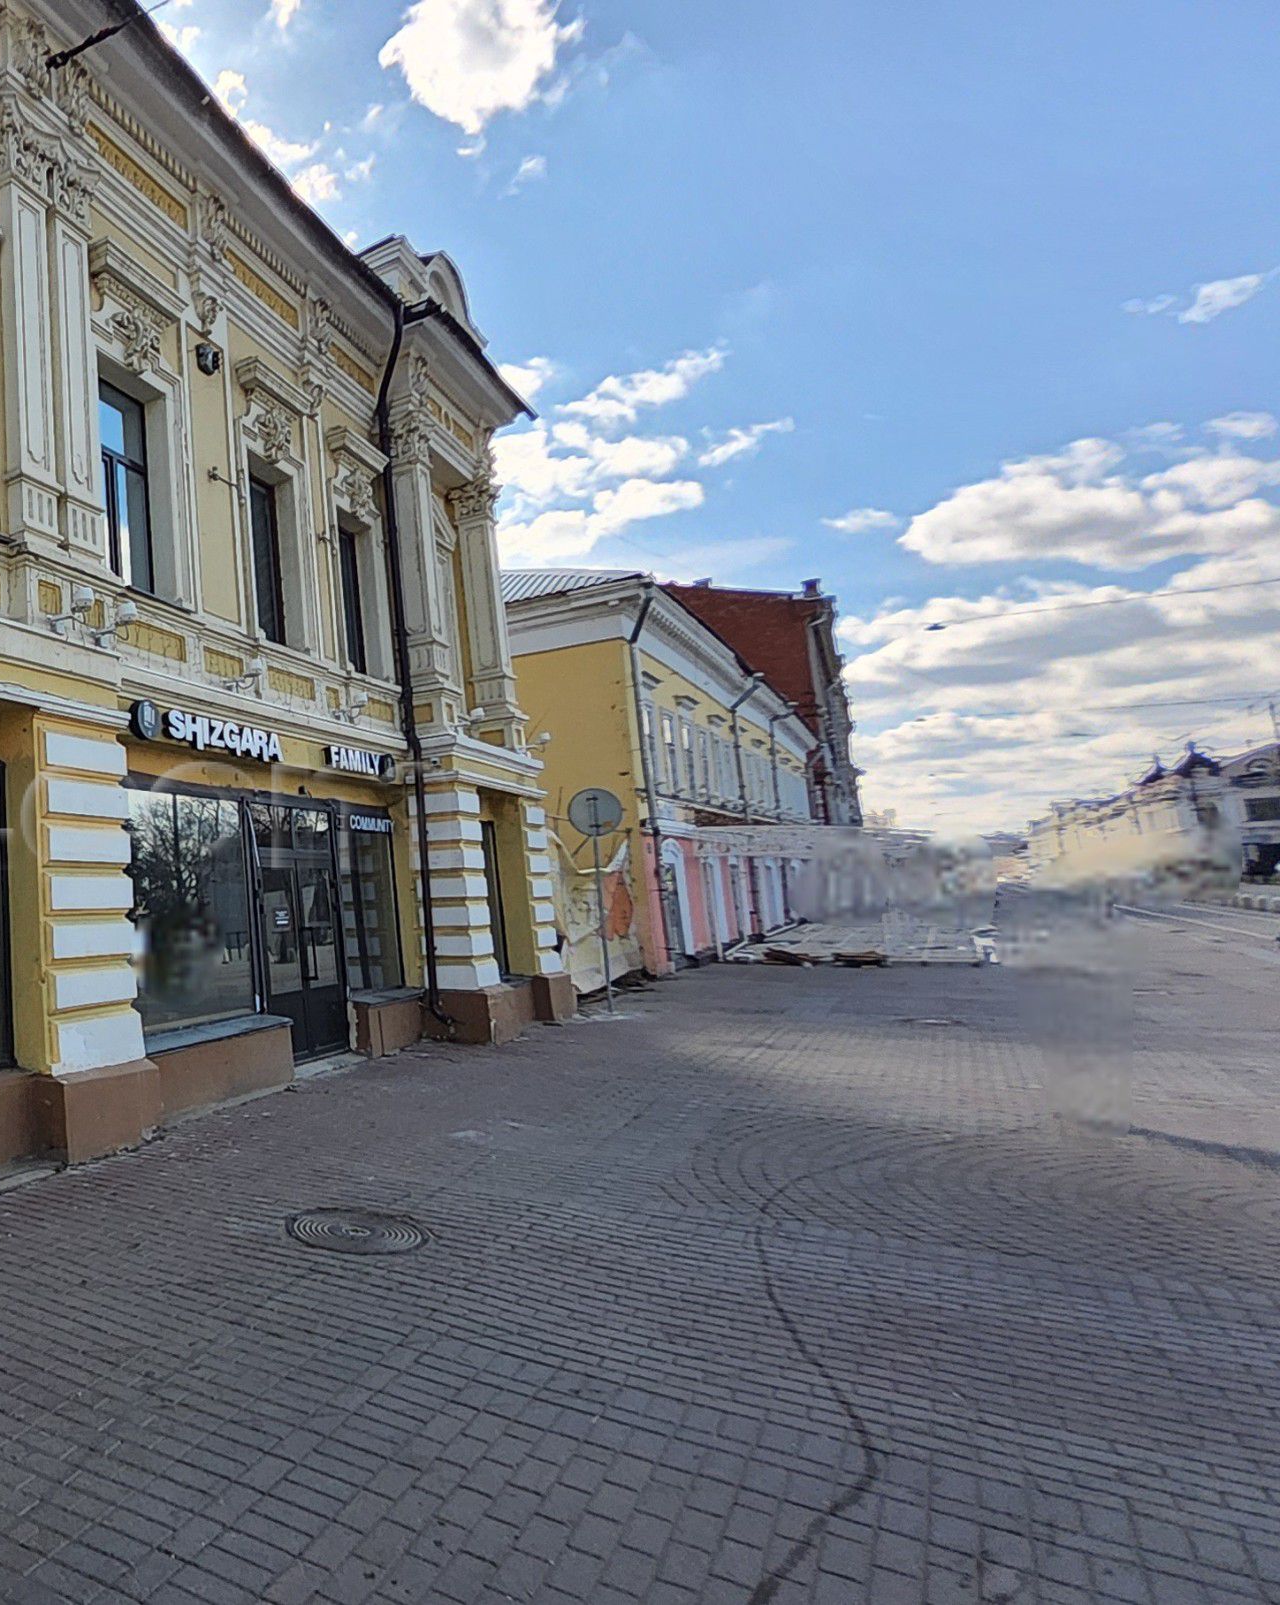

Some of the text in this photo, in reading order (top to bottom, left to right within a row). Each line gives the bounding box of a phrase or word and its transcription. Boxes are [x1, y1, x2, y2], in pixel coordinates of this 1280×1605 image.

[168, 709, 381, 776] SHIZGARA FAMILY
[349, 814, 394, 832] COMMUNITY
